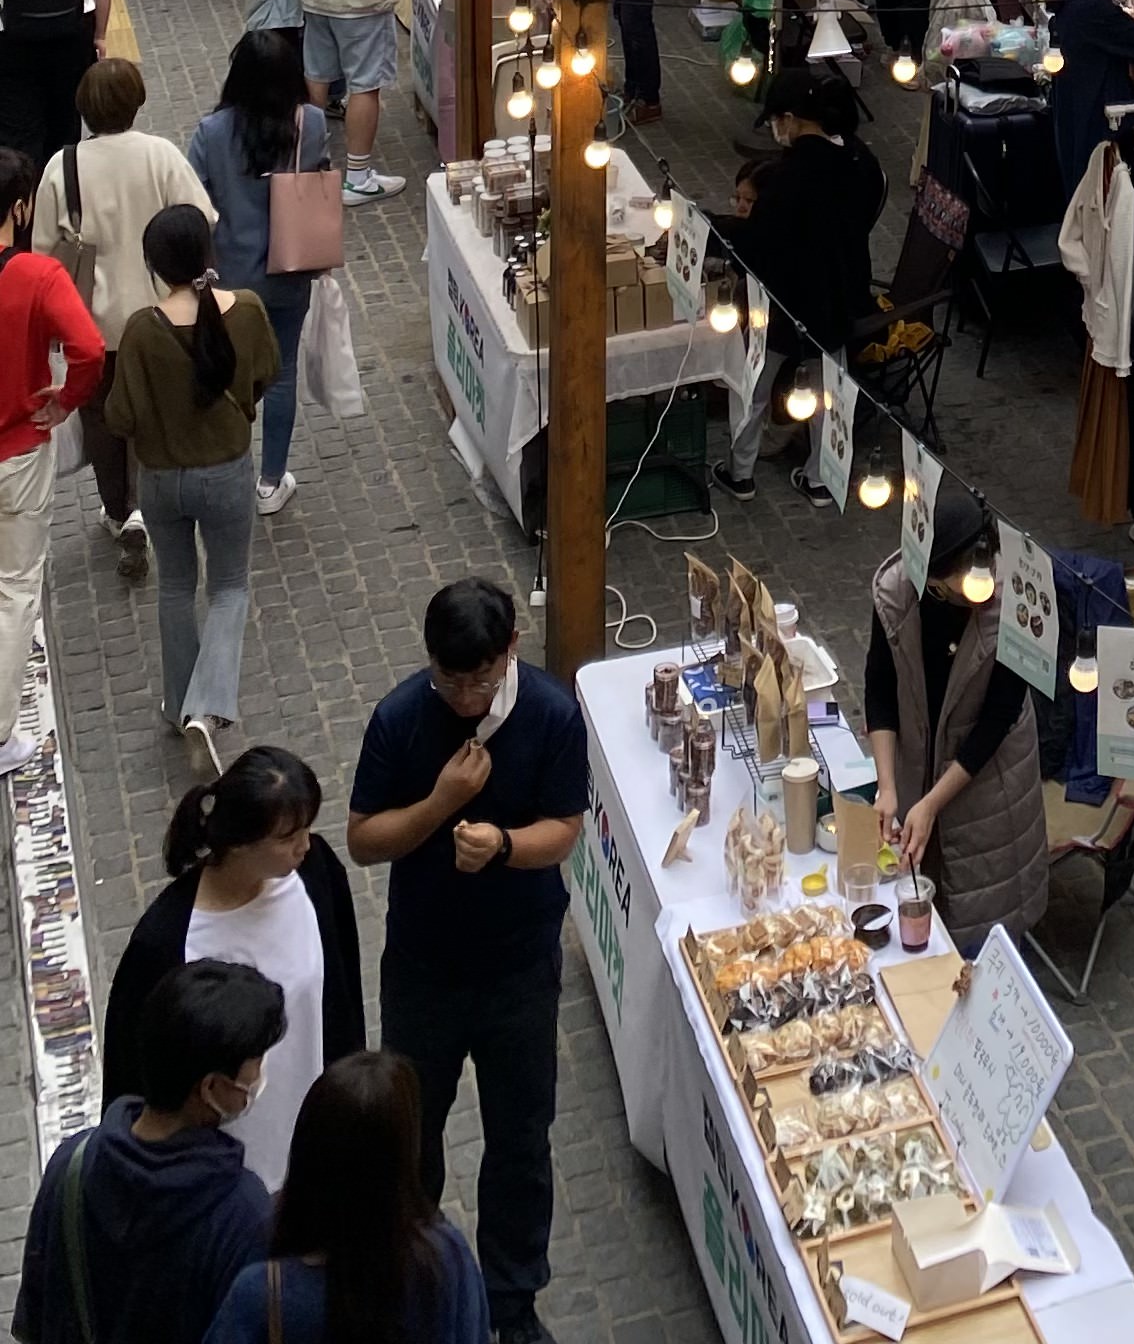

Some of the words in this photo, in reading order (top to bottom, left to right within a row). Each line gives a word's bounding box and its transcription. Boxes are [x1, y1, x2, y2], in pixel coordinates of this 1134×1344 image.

[447, 314, 486, 435] 플리마켓
[459, 292, 485, 369] KOREA
[594, 788, 632, 929] KOREA
